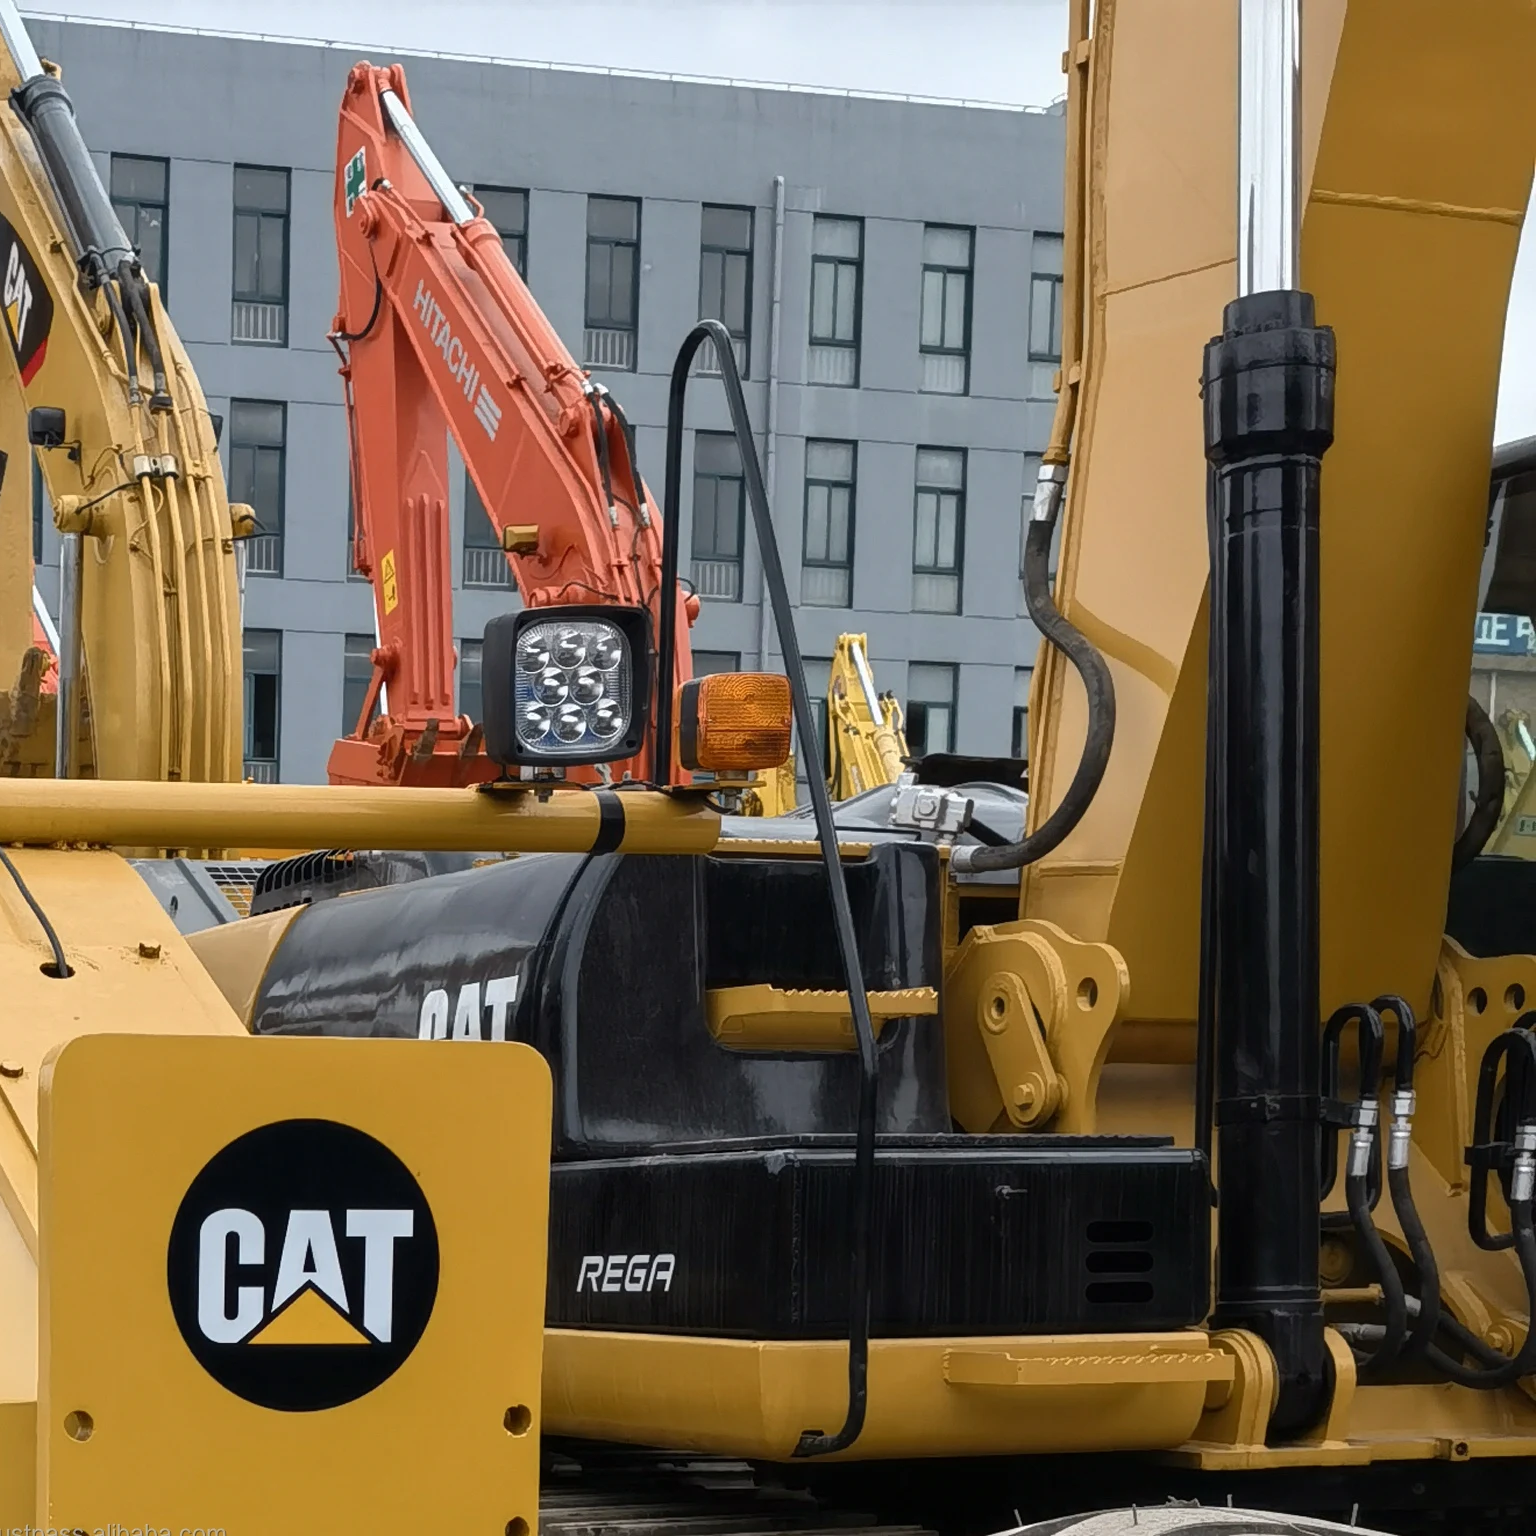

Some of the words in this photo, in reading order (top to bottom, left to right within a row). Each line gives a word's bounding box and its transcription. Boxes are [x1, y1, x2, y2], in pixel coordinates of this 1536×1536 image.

[4, 241, 33, 352] CAT
[413, 278, 480, 403] HITACHI
[198, 1207, 414, 1344] CAT
[576, 1253, 676, 1293] REGA
